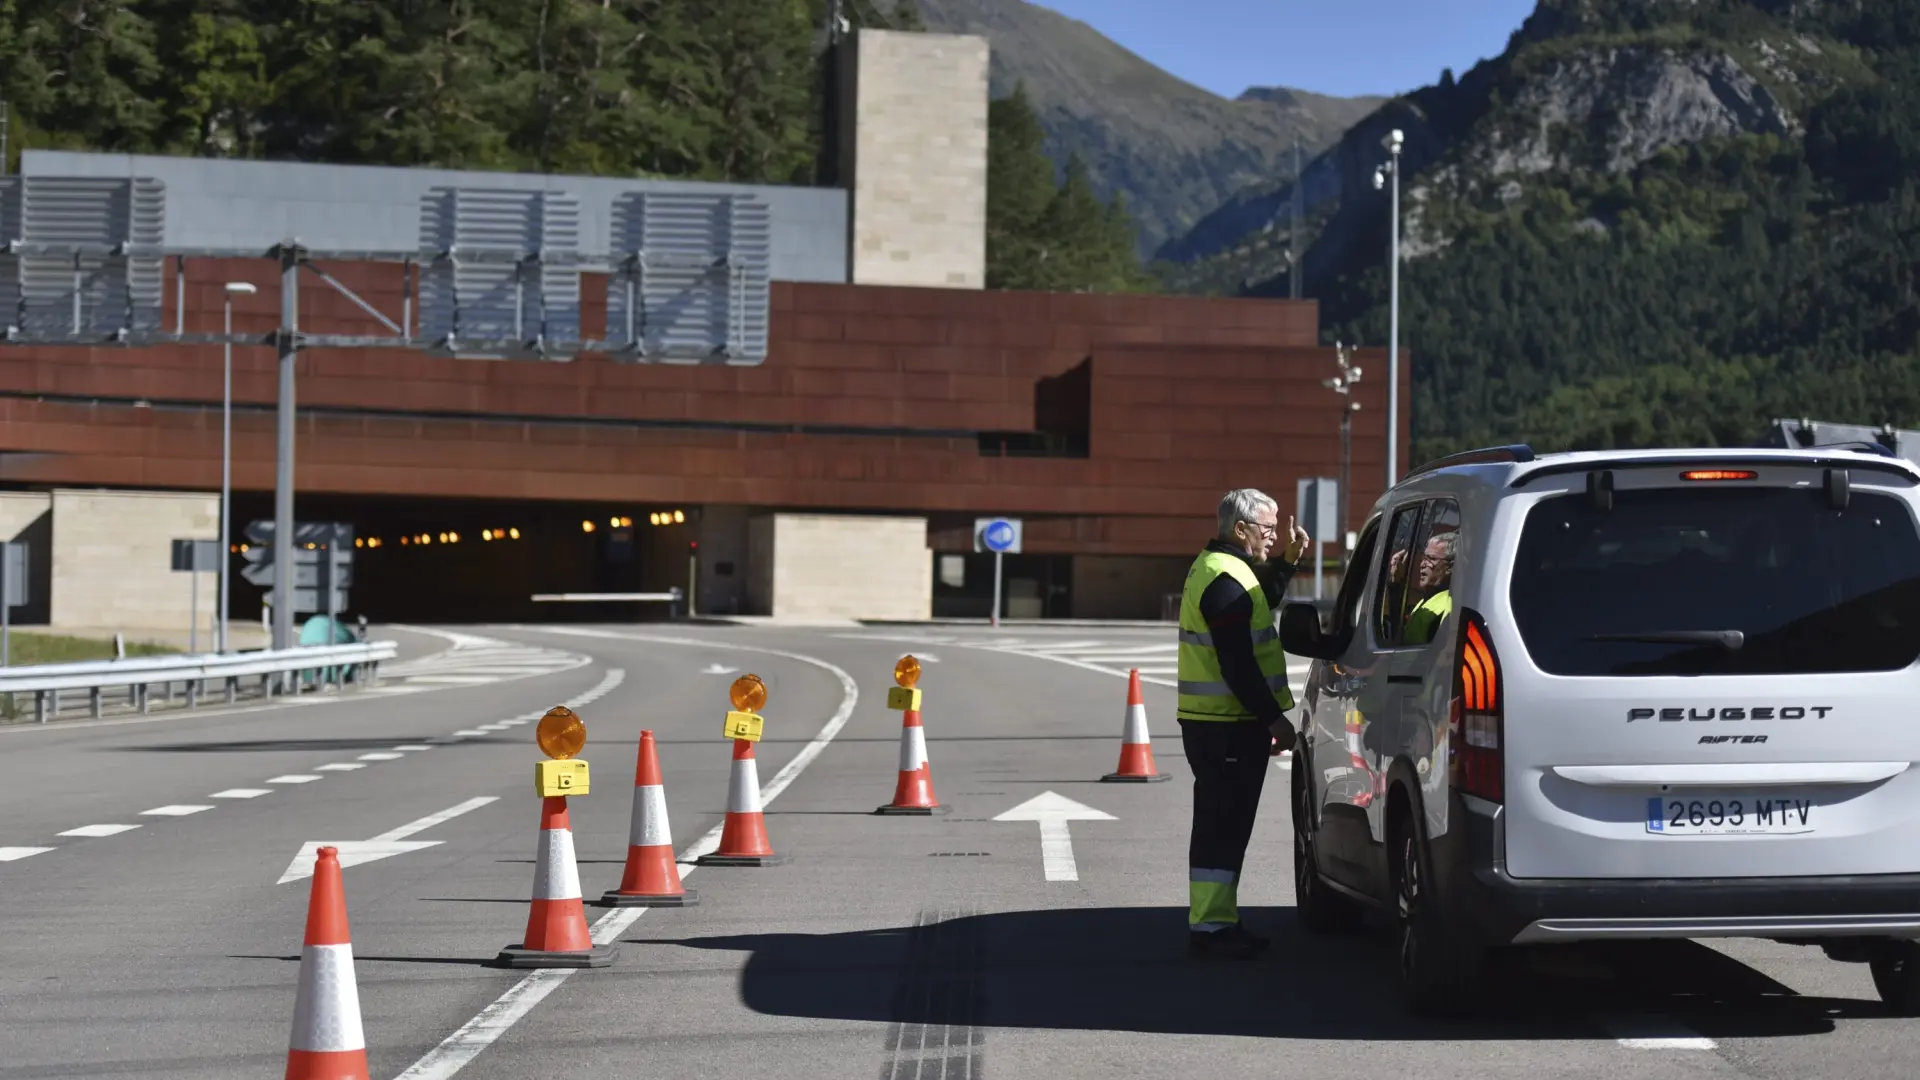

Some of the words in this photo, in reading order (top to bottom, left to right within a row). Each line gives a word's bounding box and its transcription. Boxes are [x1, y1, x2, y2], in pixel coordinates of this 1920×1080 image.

[1627, 706, 1833, 723] PEUGEOT
[1698, 735, 1768, 745] RIFTER
[1668, 800, 1744, 827] 2693
[1756, 799, 1811, 826] MTV
